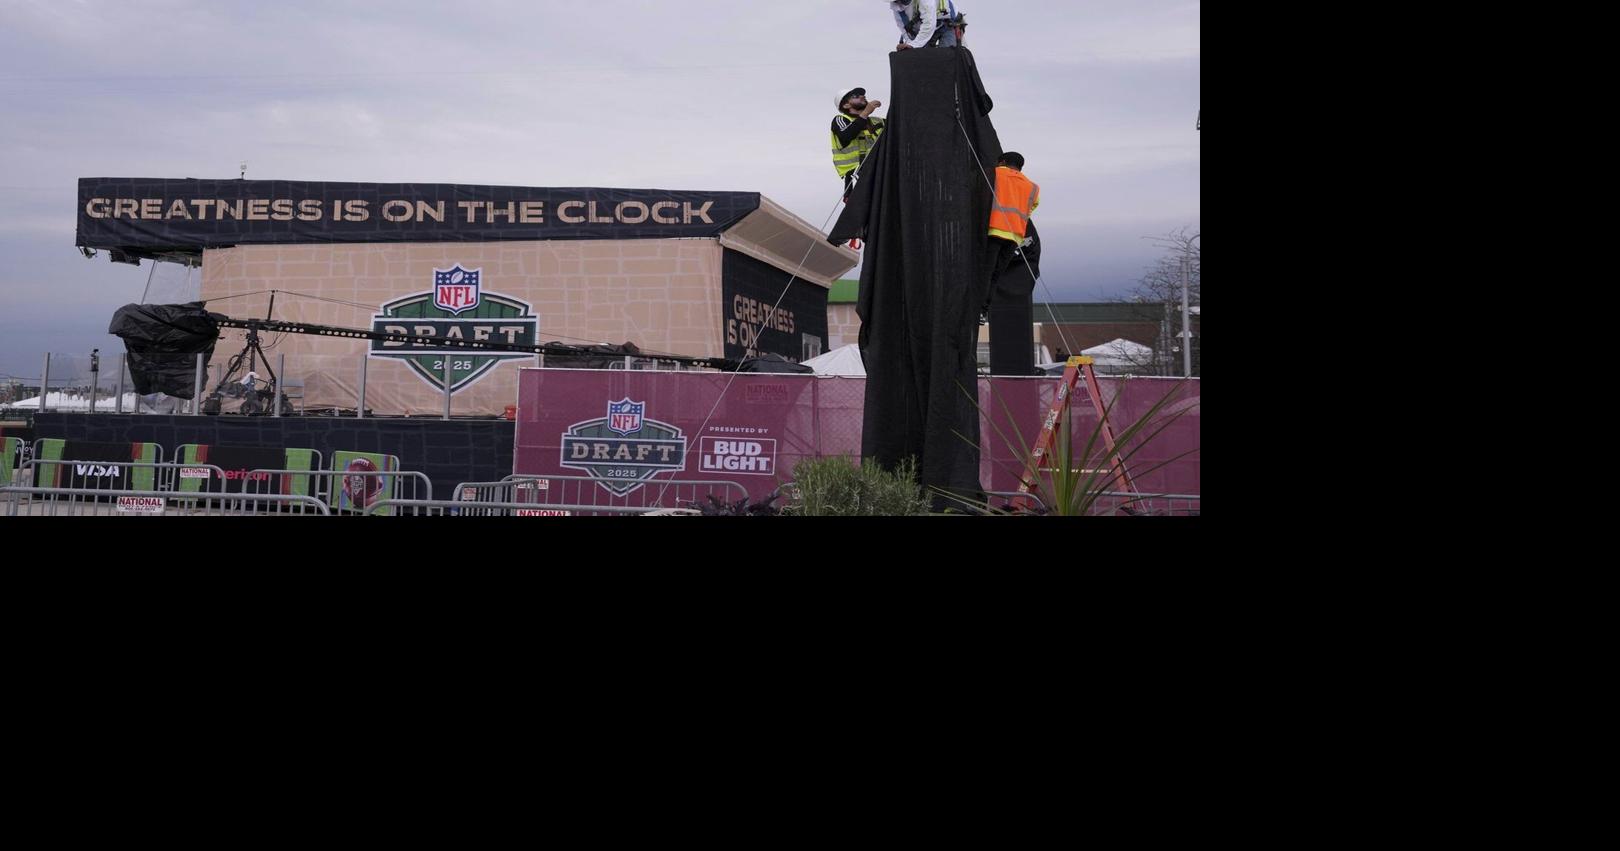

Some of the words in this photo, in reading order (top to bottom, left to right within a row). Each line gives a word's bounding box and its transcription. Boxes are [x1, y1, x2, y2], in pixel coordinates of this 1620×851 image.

[85, 197, 322, 222] GREATNESS
[333, 199, 370, 222] IS
[382, 199, 445, 223] ON
[457, 200, 544, 224] THE
[557, 200, 715, 225] CLOCK
[439, 286, 475, 308] NFL
[733, 294, 795, 334] GREATNESS
[383, 325, 525, 348] DRAFT
[740, 321, 758, 349] ON
[612, 414, 639, 433] NFL
[709, 426, 755, 434] PRESENTED
[570, 442, 676, 462] DRAFT
[714, 440, 762, 457] BUD
[73, 460, 120, 477] VISA
[703, 455, 770, 471] LIGHT
[607, 468, 637, 478] 2025
[118, 497, 163, 506] NATIONAL
